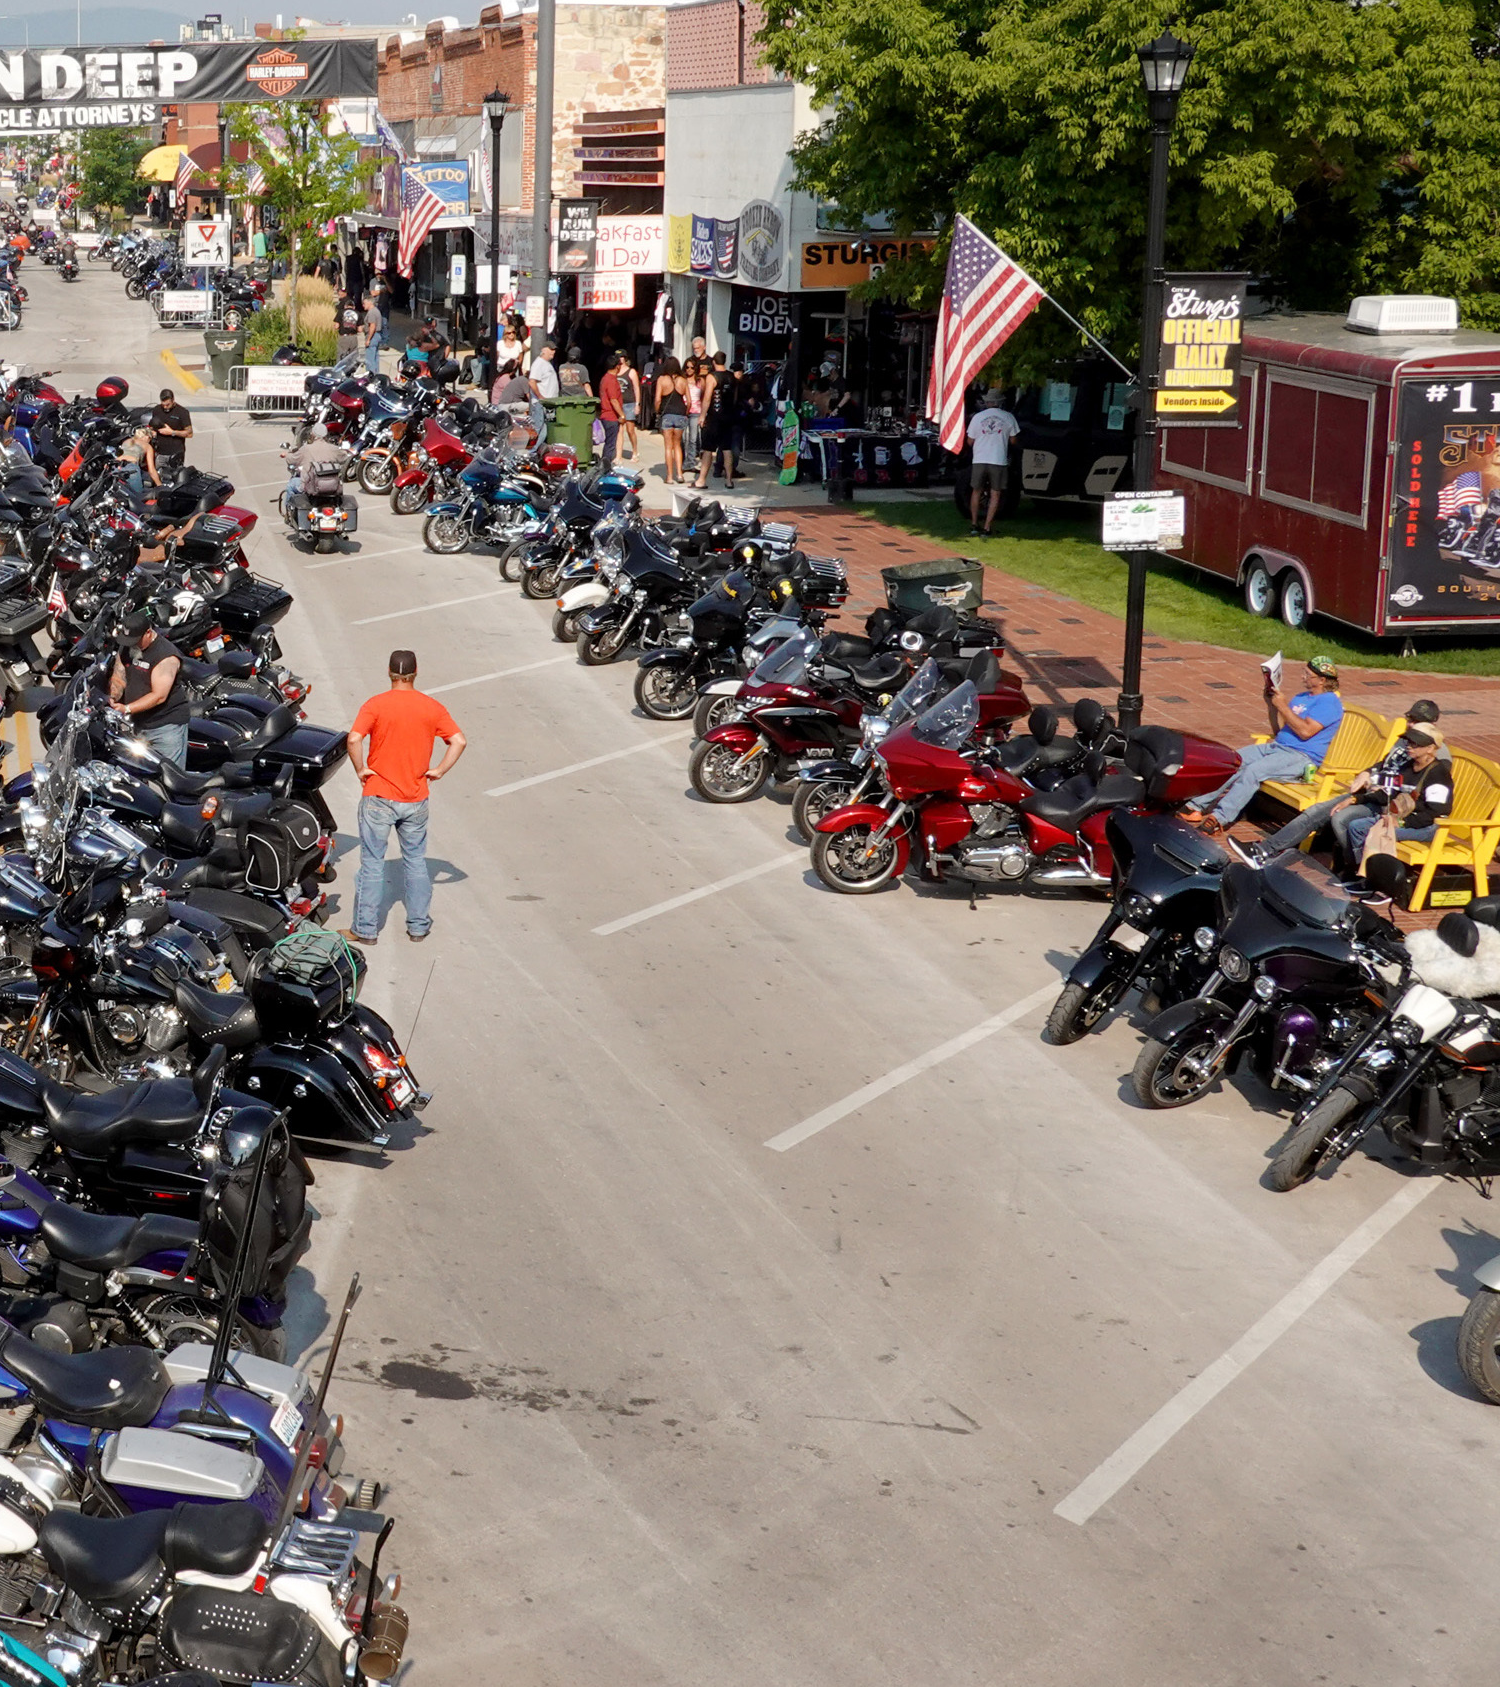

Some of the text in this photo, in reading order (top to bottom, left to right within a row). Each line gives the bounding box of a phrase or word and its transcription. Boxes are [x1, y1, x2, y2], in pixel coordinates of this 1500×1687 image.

[262, 55, 292, 64] MOTOR
[41, 53, 197, 99] DEEP
[250, 66, 306, 78] HARLEY-DAVIDSON
[262, 80, 293, 93] CYCLES
[37, 104, 156, 128] ATTORNEYS
[567, 207, 589, 218] WE
[563, 219, 592, 230] RUN
[560, 230, 596, 241] DEEP
[613, 248, 650, 267] Day
[753, 296, 789, 316] JOE
[1167, 289, 1241, 322] Sturgis
[1163, 319, 1241, 344] OFFICIAL
[1174, 345, 1228, 369] RALLY
[1164, 397, 1198, 406] Vendors
[1135, 490, 1173, 498] CONTAINER
